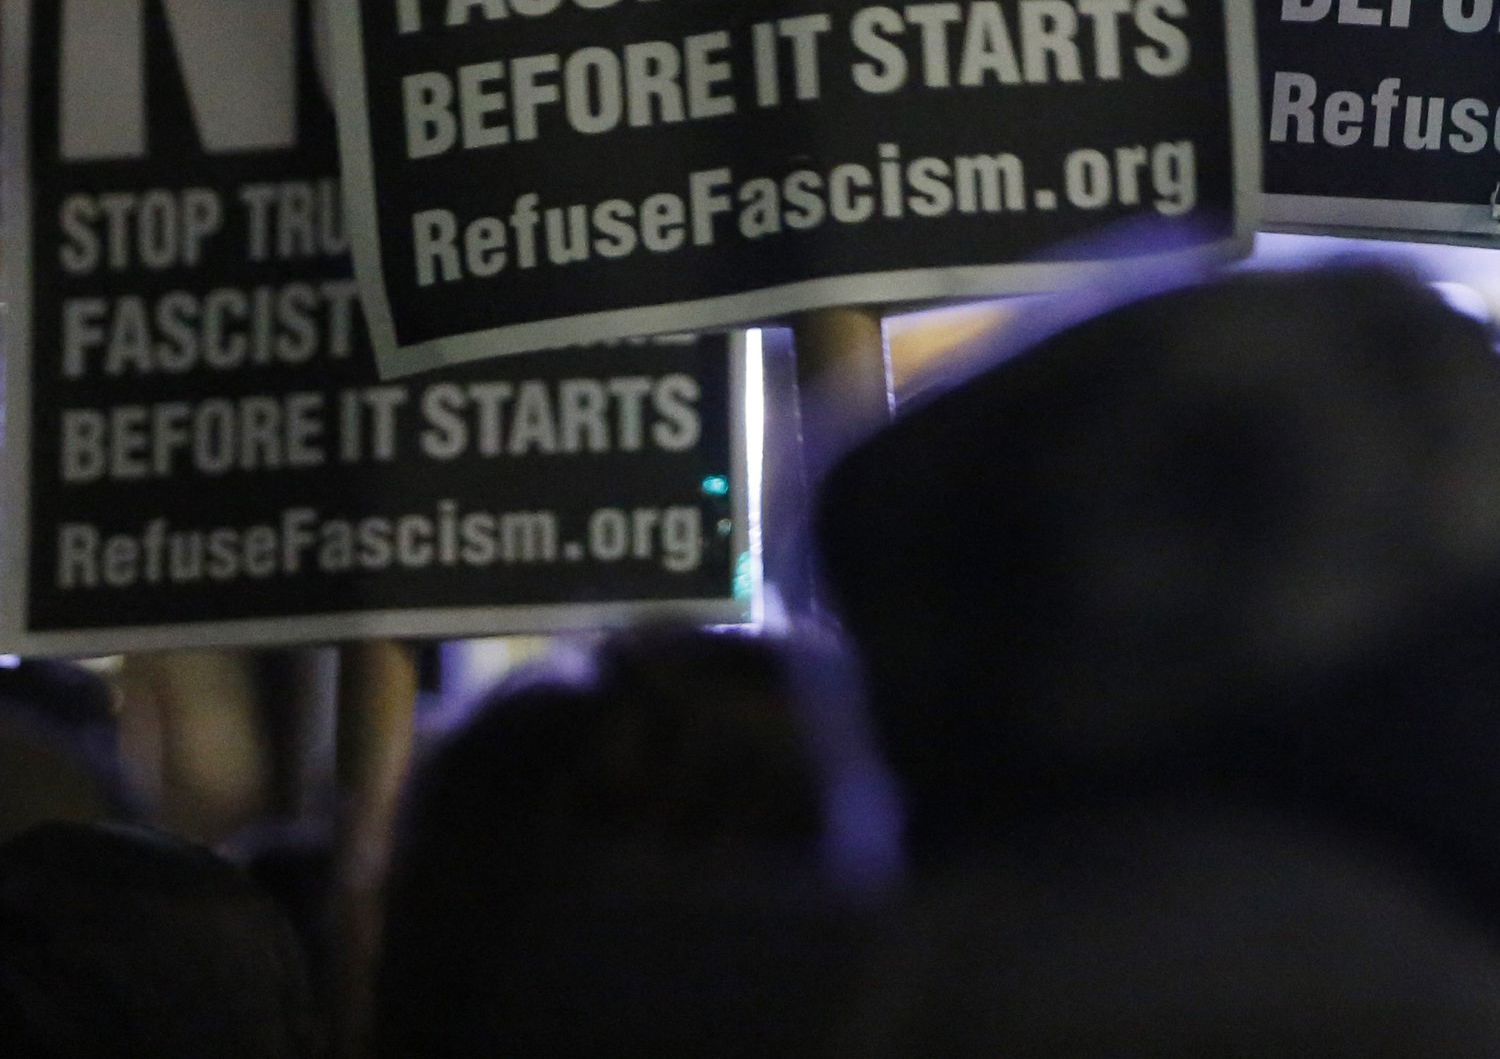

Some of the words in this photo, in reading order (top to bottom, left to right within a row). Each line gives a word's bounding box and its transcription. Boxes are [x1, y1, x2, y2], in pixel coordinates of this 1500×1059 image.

[403, 30, 735, 159] BEFORE
[751, 14, 830, 108] IT
[59, 187, 222, 274] STOP
[411, 139, 1196, 287] RefuseFascism.org
[61, 283, 358, 377] FASCIST
[61, 393, 325, 482] BEFORE
[341, 389, 406, 462] IT
[420, 371, 700, 462] STARTS
[56, 500, 701, 588] RefuseFascism.org
